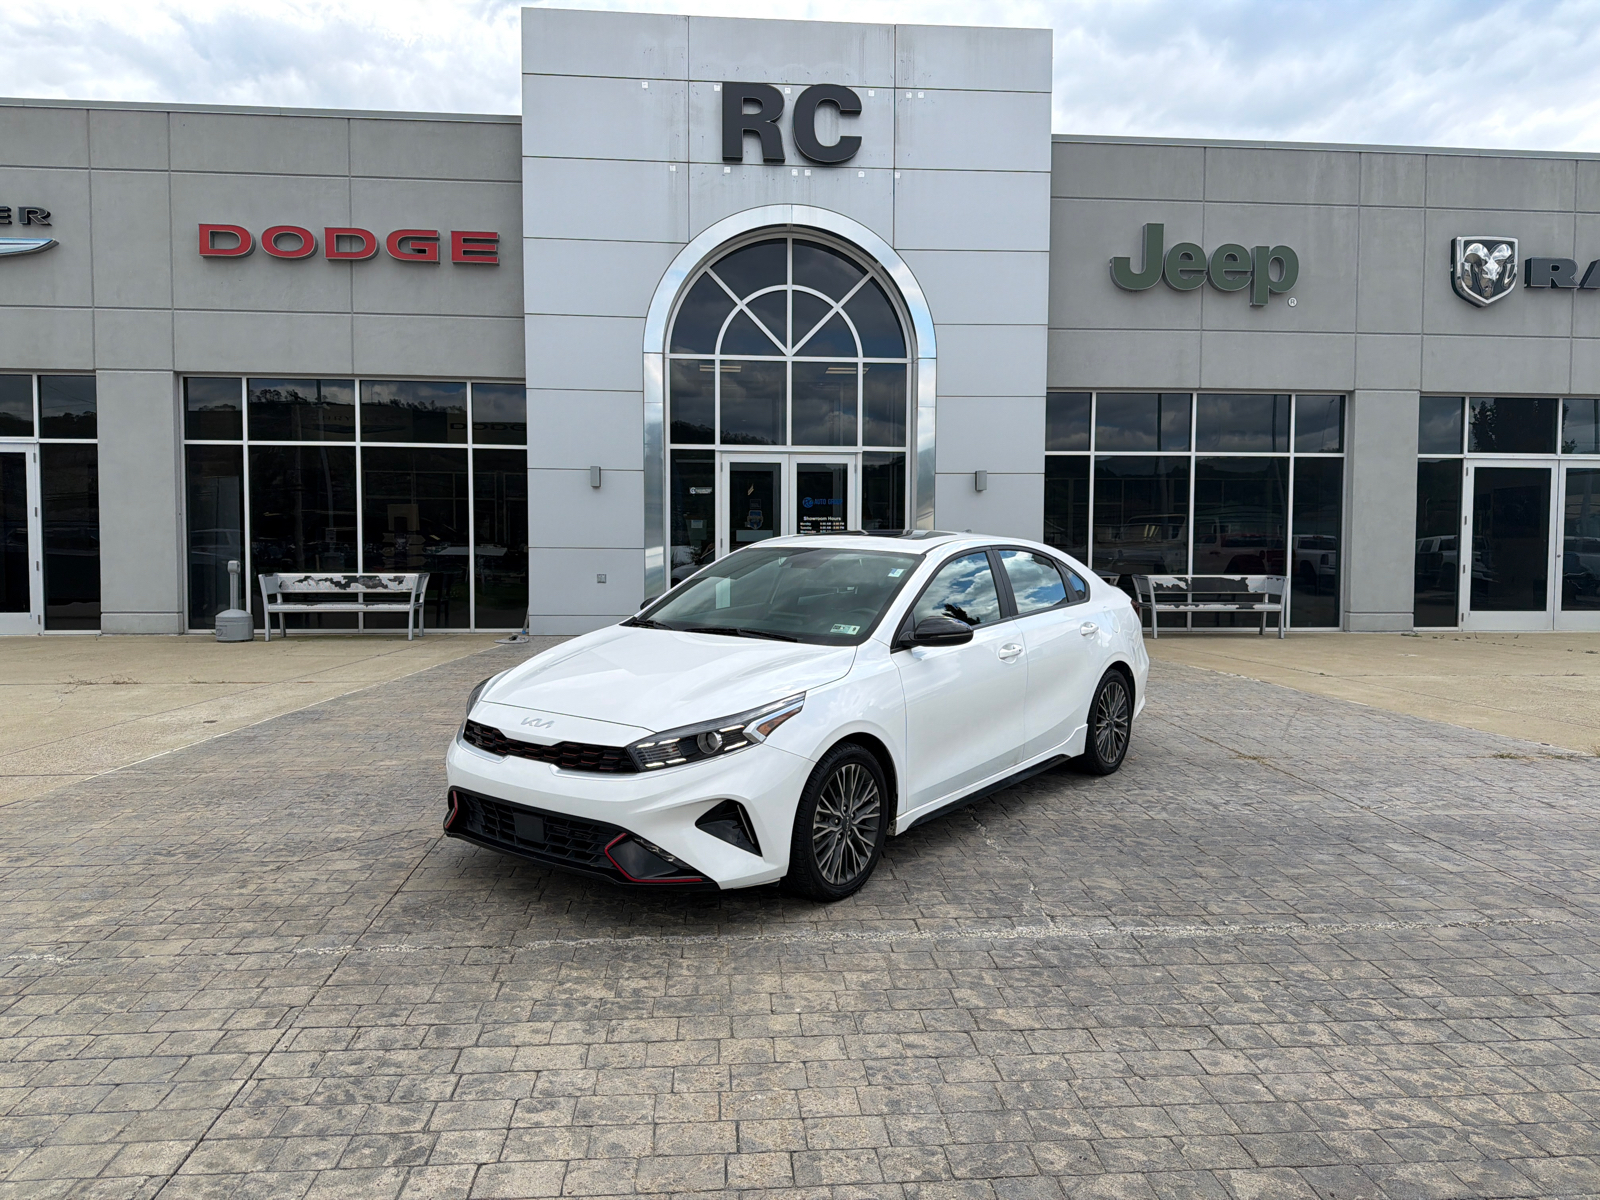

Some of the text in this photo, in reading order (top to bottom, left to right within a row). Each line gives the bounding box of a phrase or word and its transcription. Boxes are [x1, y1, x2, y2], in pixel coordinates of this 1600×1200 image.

[722, 82, 862, 165] RC
[198, 223, 499, 265] DODGE
[1110, 223, 1299, 306] Jeep
[450, 422, 526, 431] DODG
